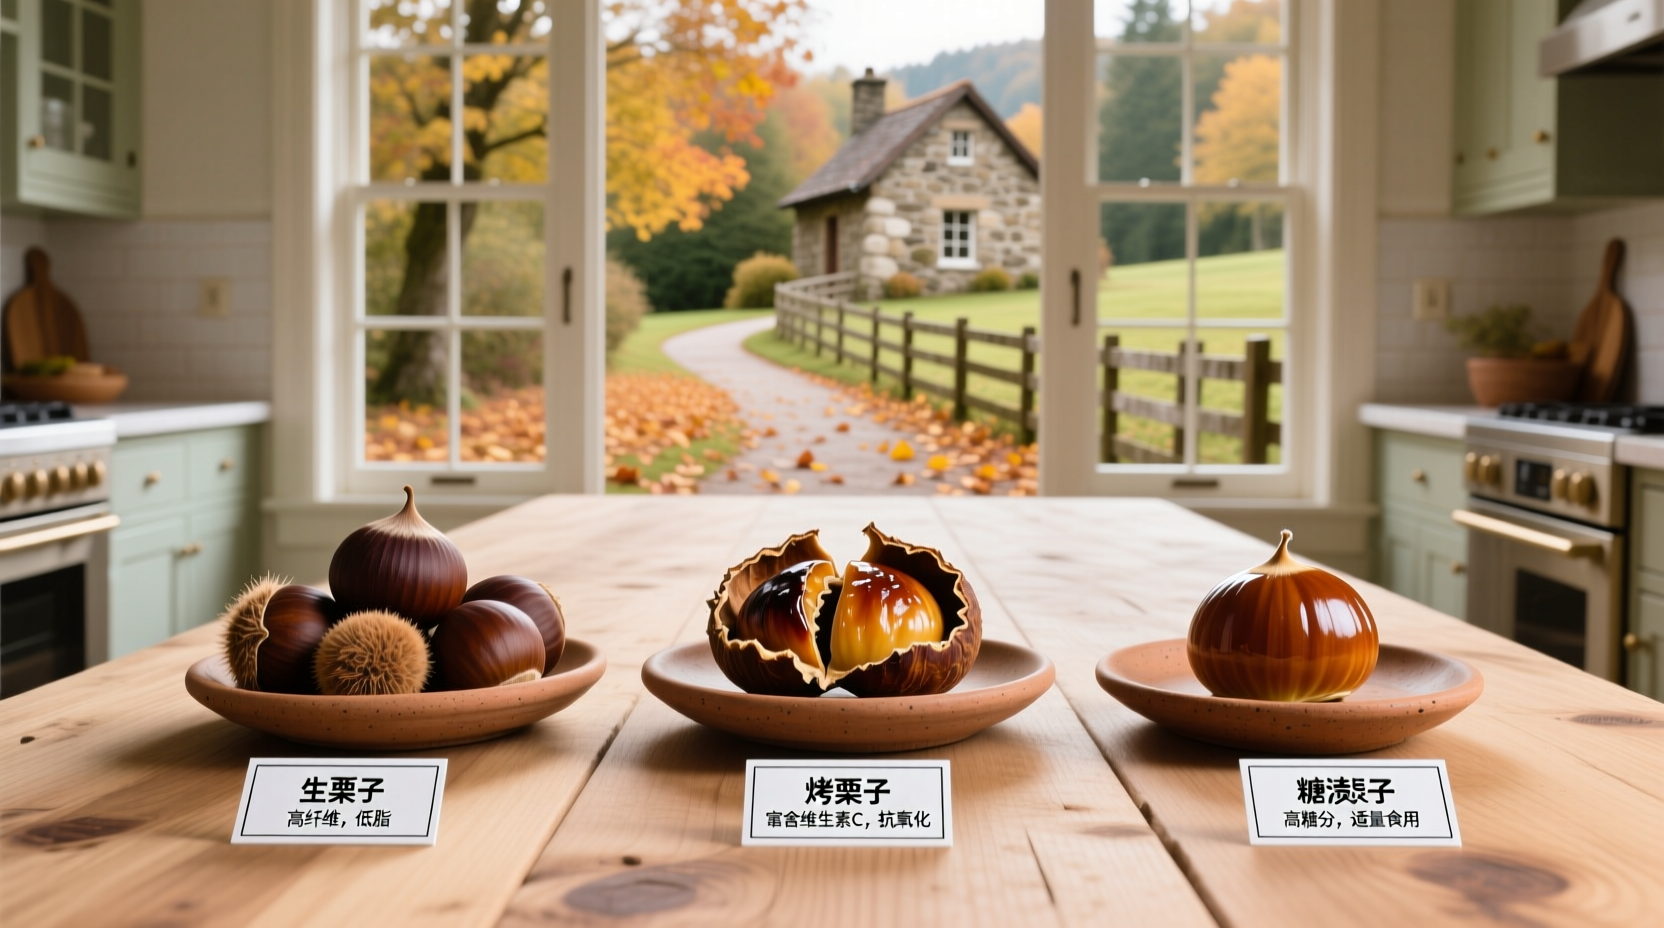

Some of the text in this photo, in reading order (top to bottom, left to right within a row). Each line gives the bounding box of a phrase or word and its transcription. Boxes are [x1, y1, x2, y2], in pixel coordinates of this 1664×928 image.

[299, 776, 385, 804] 生栗子
[804, 776, 891, 805] 烤栗子
